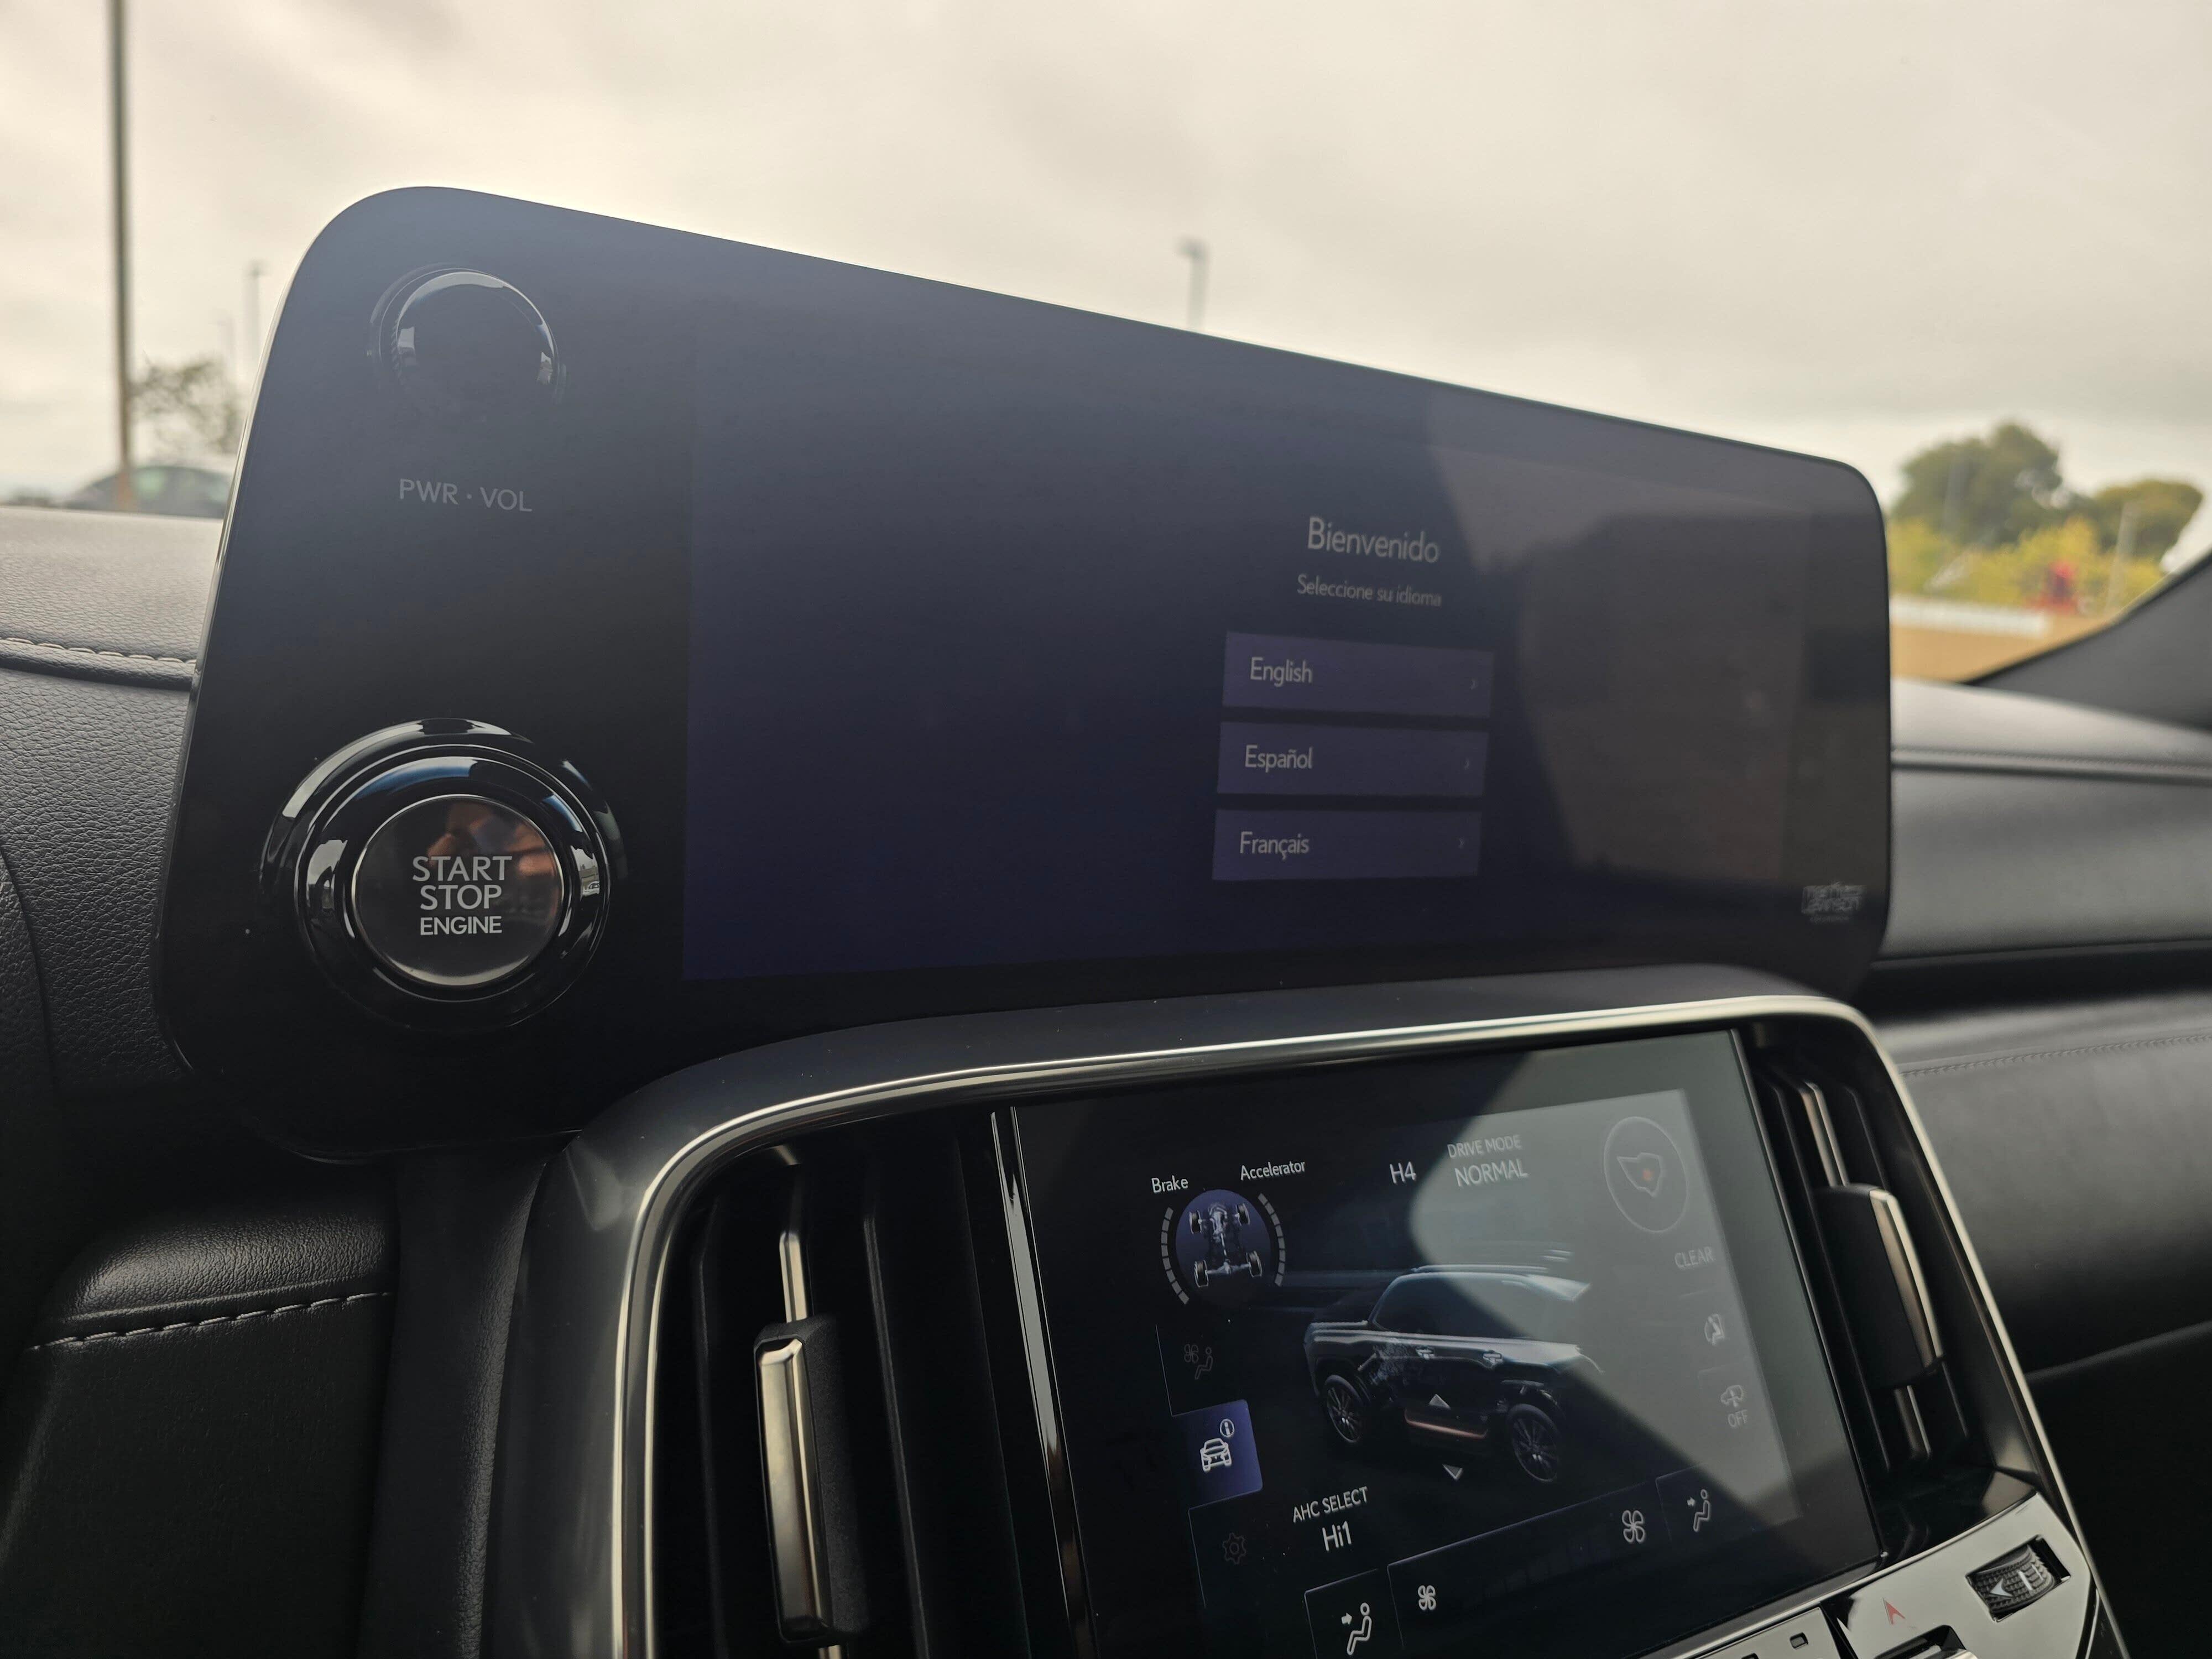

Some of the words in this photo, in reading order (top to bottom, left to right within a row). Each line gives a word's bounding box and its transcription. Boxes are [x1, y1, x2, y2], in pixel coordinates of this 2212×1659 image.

[399, 478, 458, 505] PWR
[479, 487, 533, 512] VOL
[1307, 515, 1441, 564] Bienvenido
[1297, 572, 1374, 601] Seleccione
[1377, 588, 1394, 602] su
[1396, 584, 1443, 608] idioma
[1250, 656, 1313, 688] English
[1244, 744, 1313, 773] Español
[1239, 831, 1310, 861] Français
[413, 855, 513, 882] START
[420, 884, 502, 911] STOP
[420, 915, 503, 936] ENGINE
[1447, 1139, 1483, 1159] DRIVE
[1485, 1134, 1522, 1152] MODE
[1151, 1175, 1189, 1193] Brake
[1240, 1160, 1306, 1181] Accelerator
[1389, 1161, 1416, 1185] H4
[1454, 1159, 1529, 1187] NORMAL
[1674, 1246, 1715, 1269] CLEAR
[1728, 1409, 1748, 1427] OFF
[1293, 1500, 1321, 1524] AHC
[1322, 1485, 1369, 1514] SELECT
[1322, 1520, 1352, 1552] Hi1
